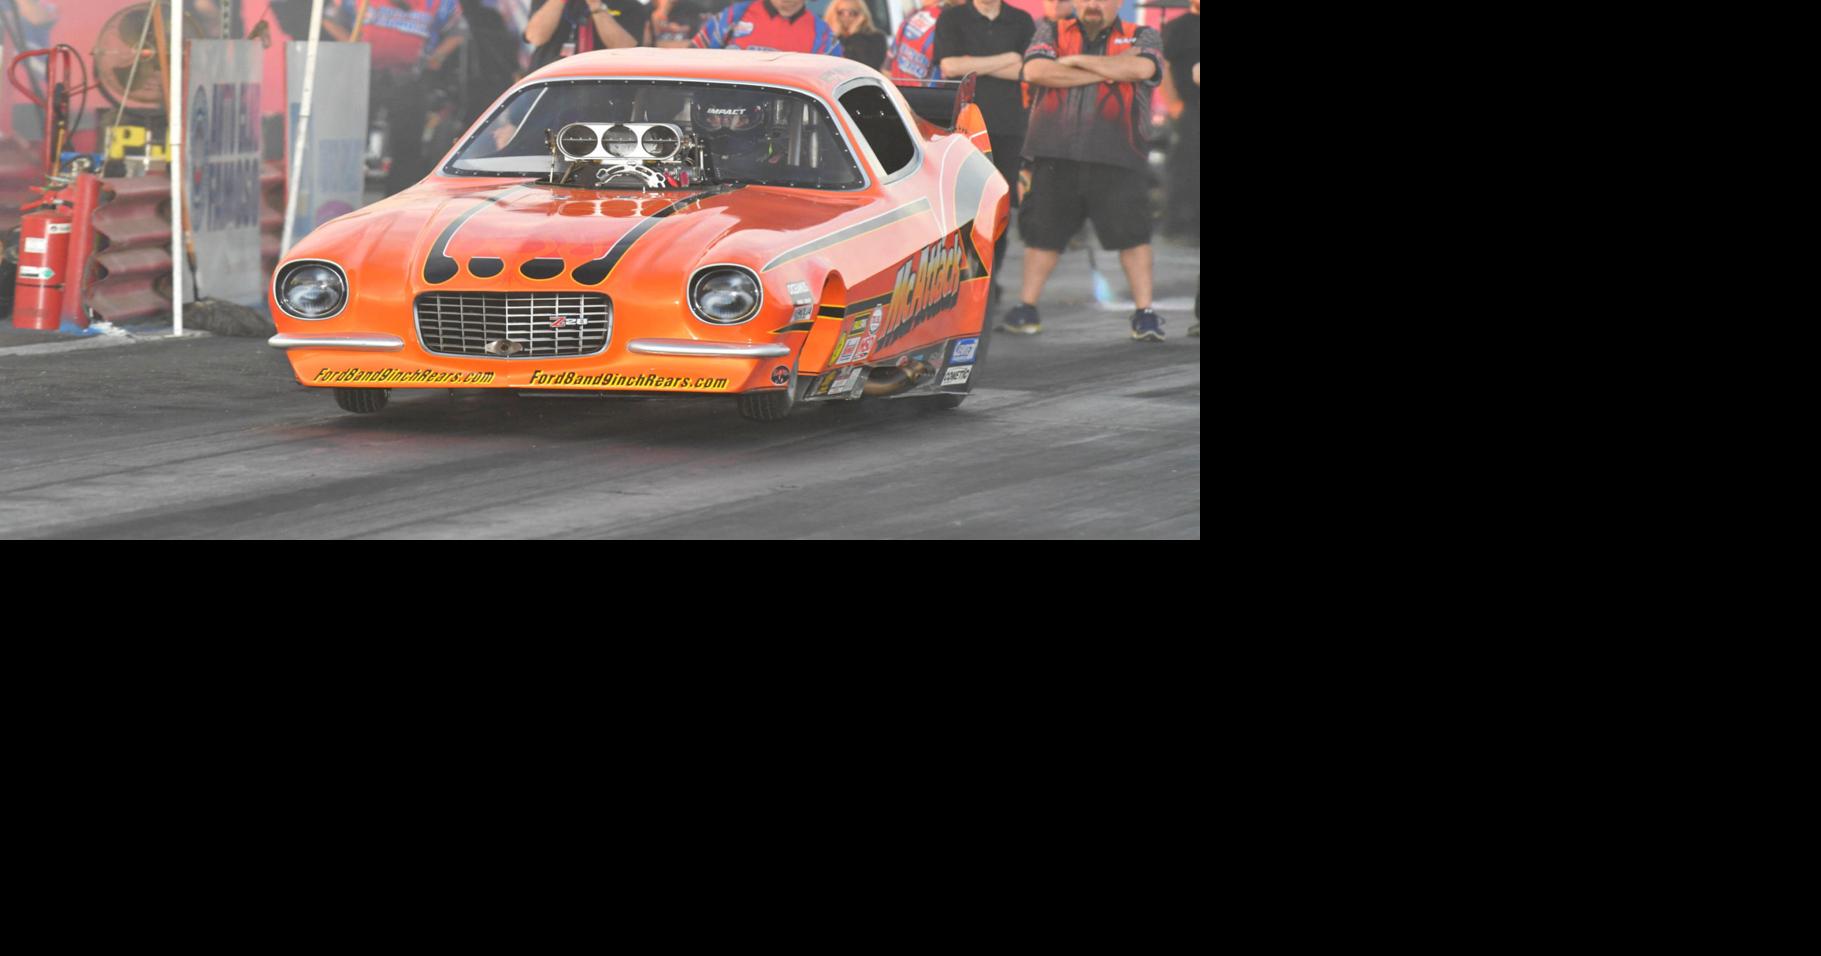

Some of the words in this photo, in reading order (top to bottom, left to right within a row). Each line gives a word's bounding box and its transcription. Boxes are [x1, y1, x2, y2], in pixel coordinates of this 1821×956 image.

[706, 107, 746, 115] IMPACT
[313, 367, 496, 385] Ford8and9inchRears.com
[529, 369, 729, 390] Ford8and9inchRears.com
